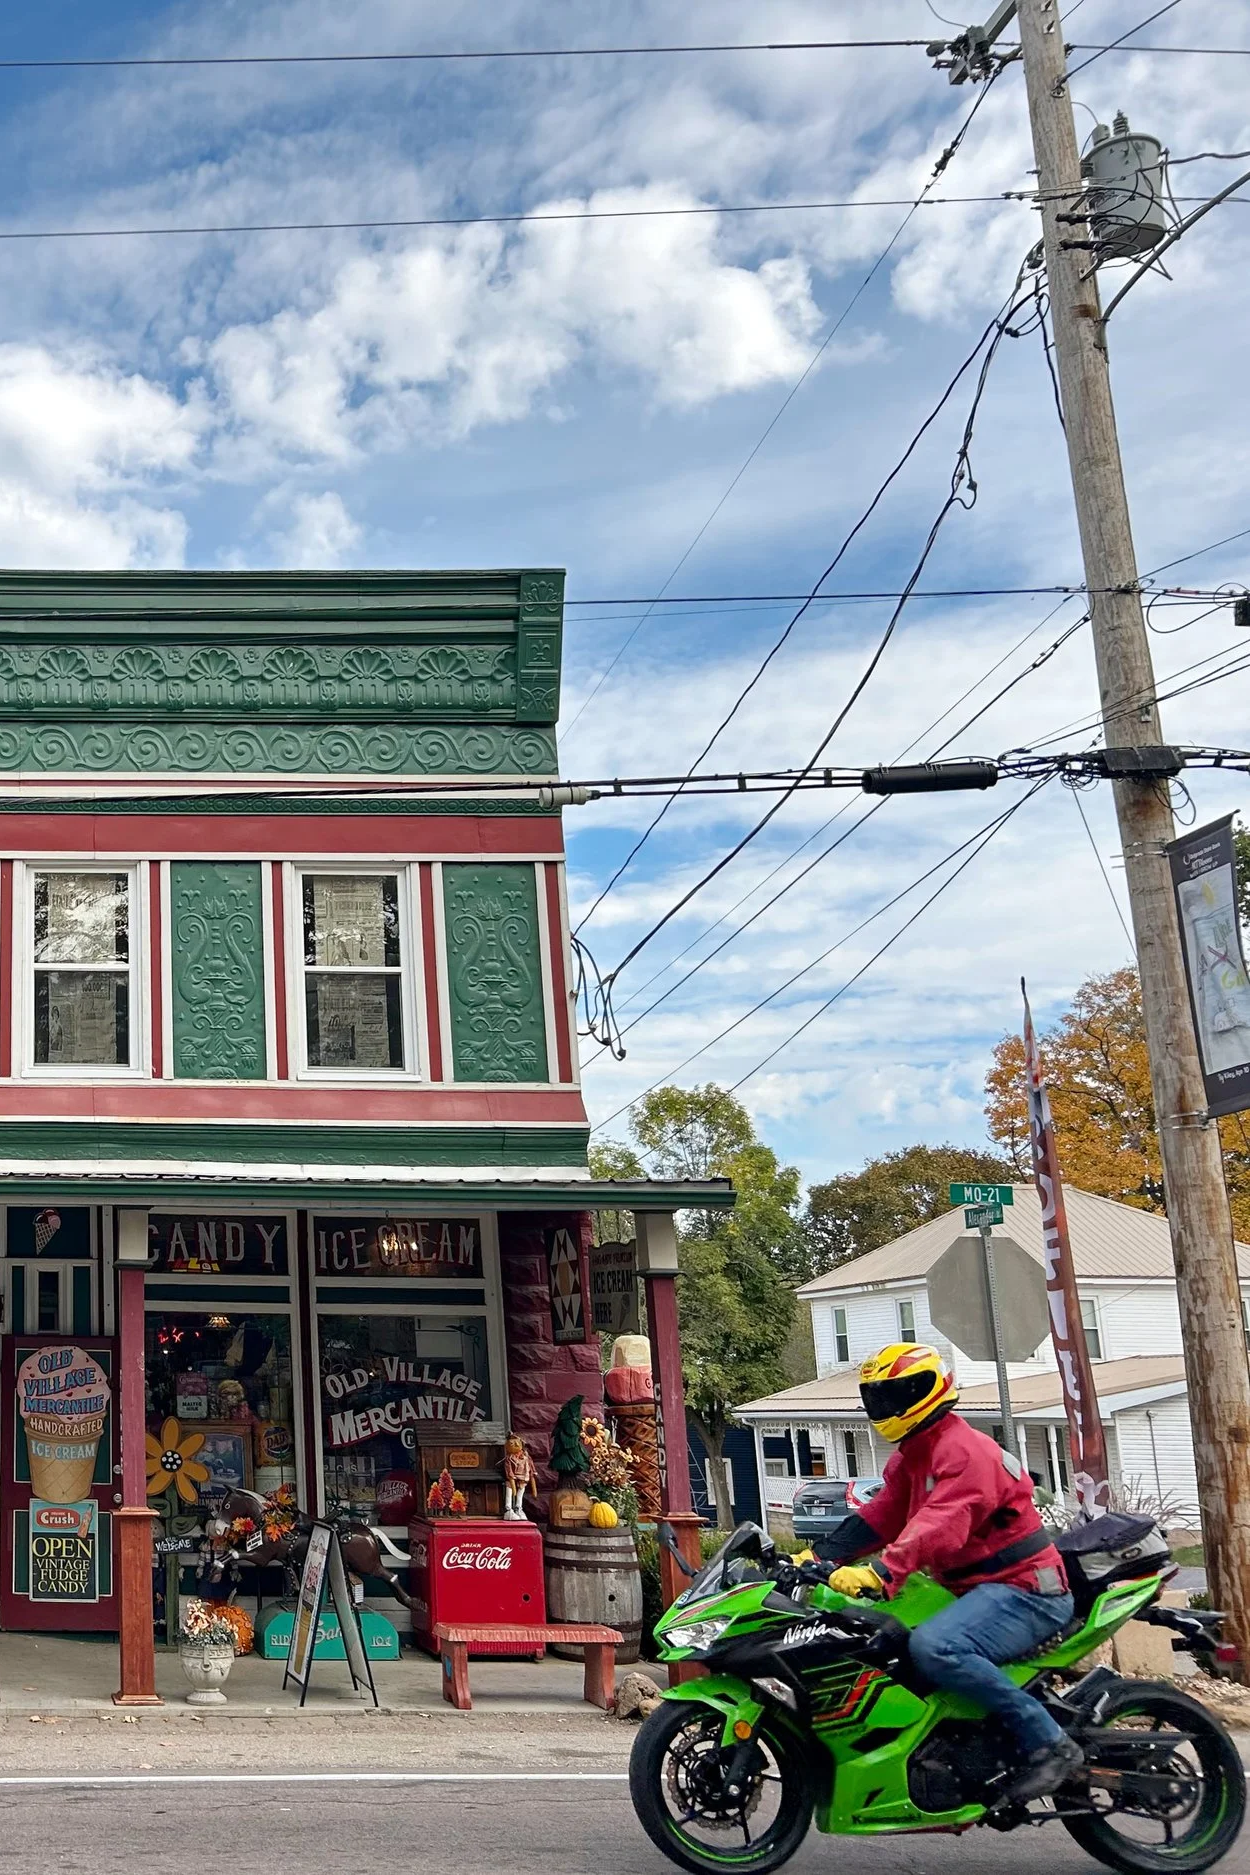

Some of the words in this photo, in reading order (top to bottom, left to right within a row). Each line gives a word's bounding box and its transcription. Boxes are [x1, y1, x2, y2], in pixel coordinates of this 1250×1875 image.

[963, 1186, 1000, 1203] MO-21
[318, 1228, 372, 1270] ICE
[377, 1221, 475, 1266] CREAM
[593, 1271, 606, 1294] ICE
[606, 1269, 633, 1293] CREAM
[595, 1302, 612, 1324] HERE
[38, 1349, 73, 1375] OLD
[24, 1367, 97, 1397] VILLAGE
[325, 1368, 369, 1399] OLD
[382, 1356, 483, 1401] VILLAGE
[24, 1394, 104, 1415] MERCANTILE
[30, 1418, 103, 1437] HANDCRAFTED
[330, 1395, 486, 1446] MERCANTILE
[653, 1383, 668, 1488] CANDY
[31, 1440, 50, 1458] ICE
[55, 1442, 95, 1459] CREAM
[40, 1512, 75, 1525] Crush
[32, 1537, 94, 1558] OPEN
[442, 1546, 513, 1570] Coca-Cola
[36, 1558, 90, 1570] VINTAGE
[40, 1568, 89, 1581] FUDGE
[38, 1581, 89, 1593] CANDY
[271, 1634, 291, 1645] RID
[783, 1620, 830, 1645] Ninja
